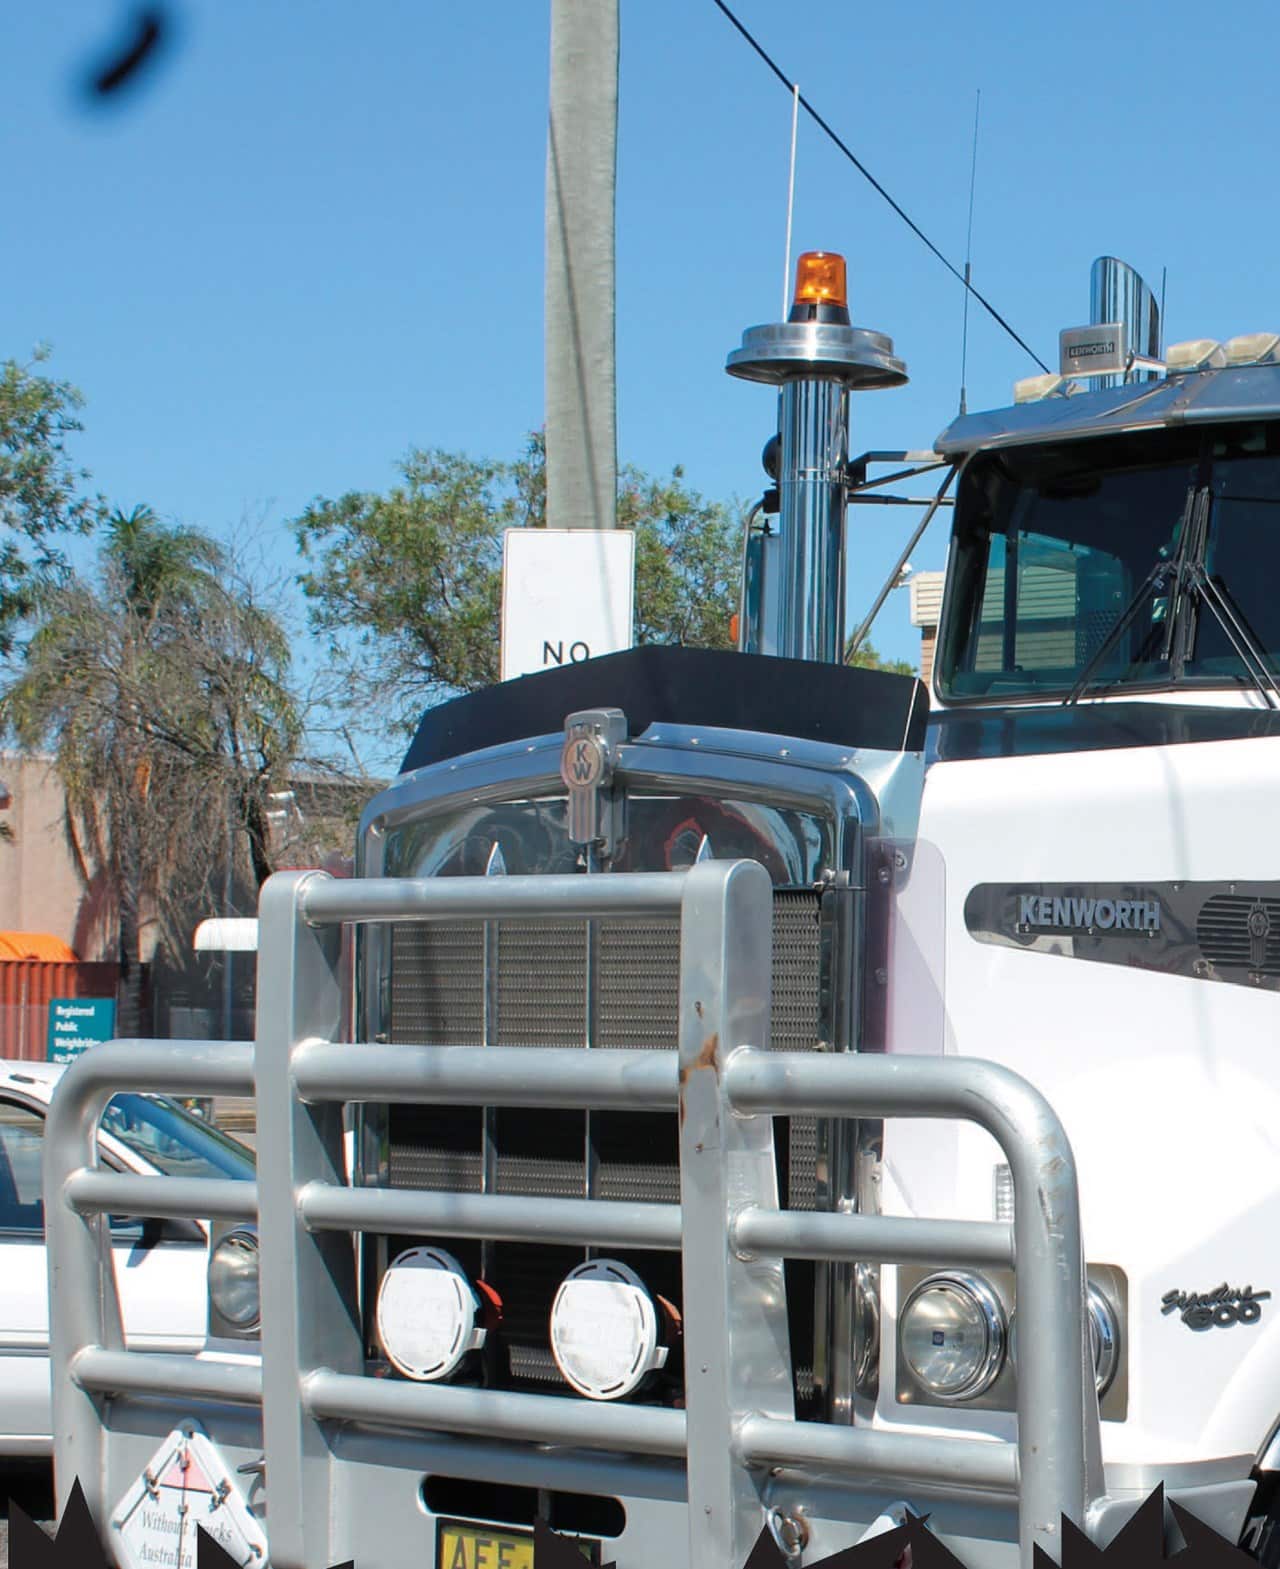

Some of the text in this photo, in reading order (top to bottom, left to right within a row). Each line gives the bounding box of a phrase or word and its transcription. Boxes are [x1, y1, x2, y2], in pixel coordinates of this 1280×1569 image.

[543, 640, 590, 664] NO
[1018, 895, 1161, 930] KENWORTH
[56, 1006, 95, 1018] Registered
[55, 1022, 78, 1032] Public
